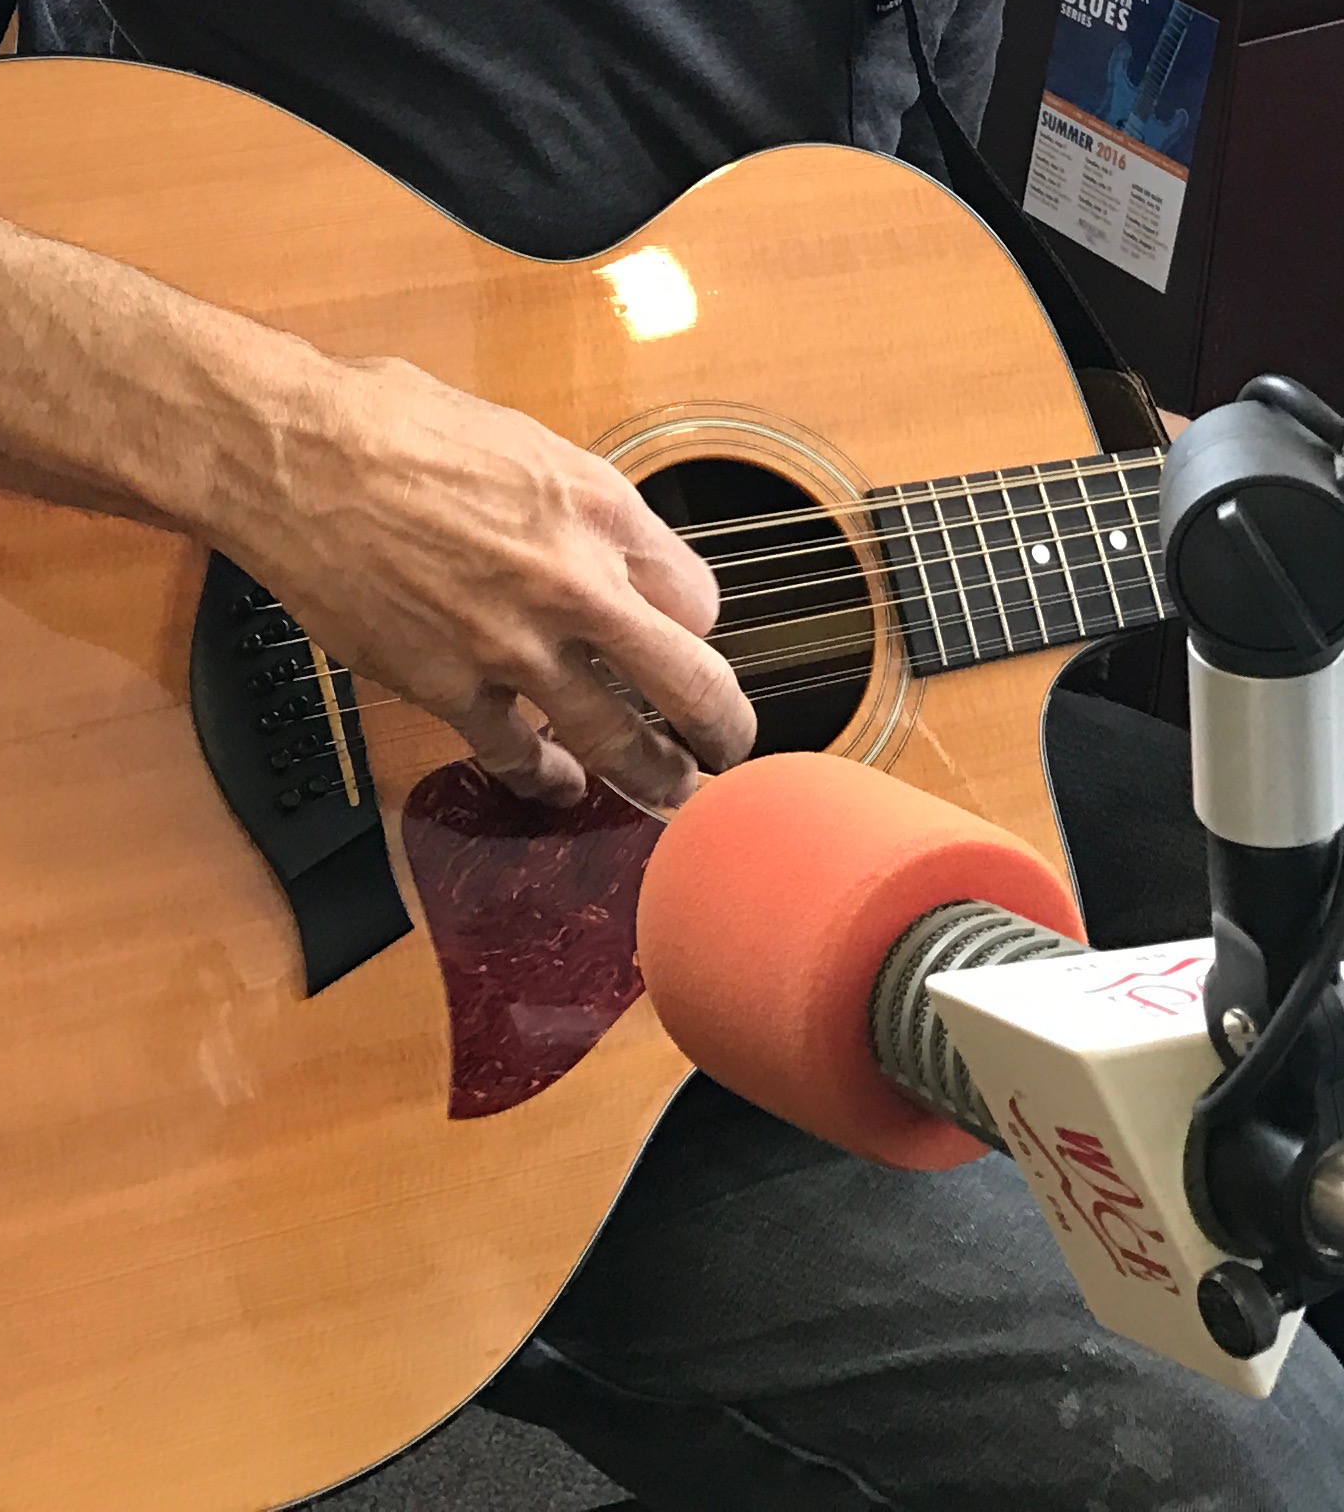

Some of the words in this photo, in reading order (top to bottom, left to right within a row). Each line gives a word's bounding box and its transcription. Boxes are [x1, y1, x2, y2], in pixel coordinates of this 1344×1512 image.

[1061, 2, 1092, 28] SERIES
[1040, 110, 1094, 153] SUMMER
[1096, 141, 1127, 171] 2016
